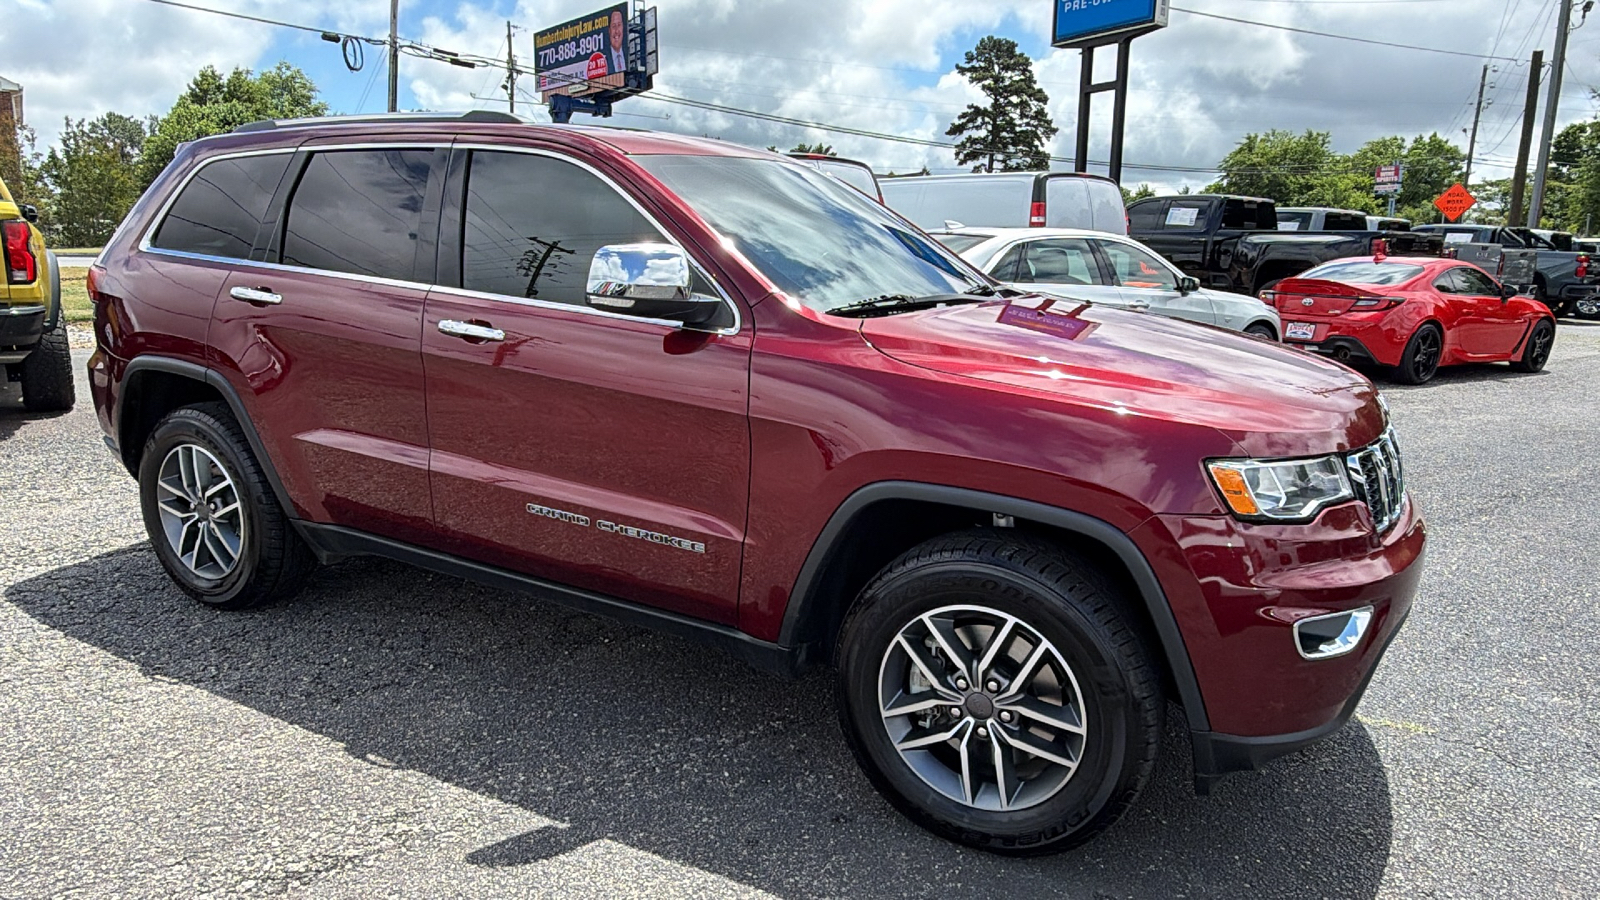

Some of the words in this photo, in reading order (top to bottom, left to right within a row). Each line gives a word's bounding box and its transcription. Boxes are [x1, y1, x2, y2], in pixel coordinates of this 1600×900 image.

[539, 32, 604, 67] 770-888-8901
[526, 503, 590, 526] GRAND
[596, 519, 706, 554] CHEROKEE
